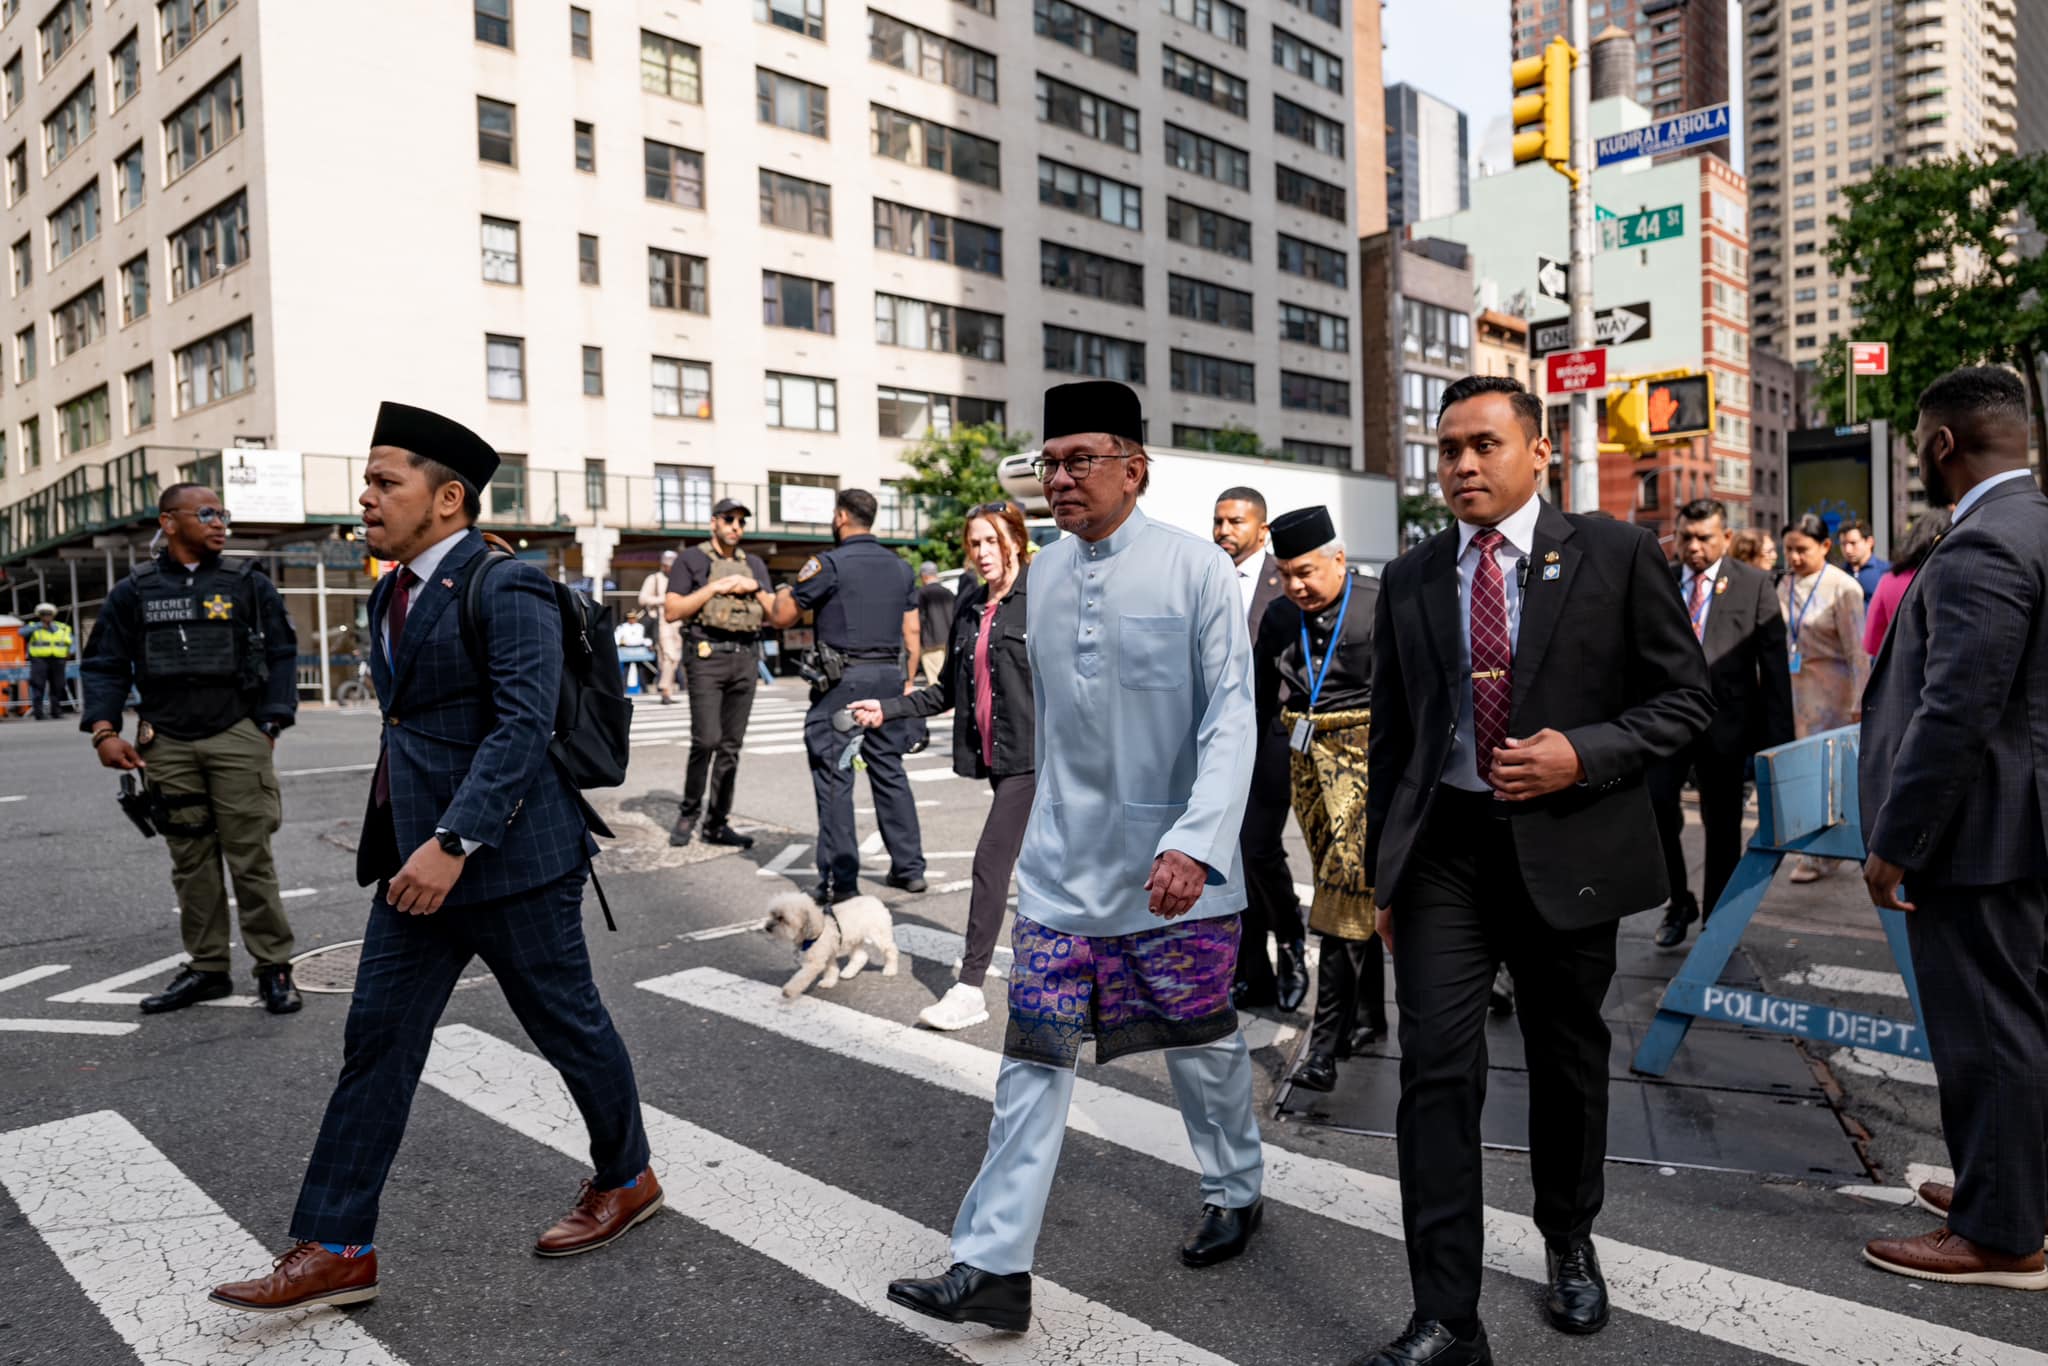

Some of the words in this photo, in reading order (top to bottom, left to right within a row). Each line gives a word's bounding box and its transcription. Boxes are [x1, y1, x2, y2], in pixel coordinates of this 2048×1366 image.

[1600, 124, 1661, 157] KUDIRAT
[1667, 107, 1727, 138] ABIOLA
[1619, 220, 1629, 245] E
[1635, 212, 1660, 241] 44
[1596, 318, 1630, 336] WAY
[1555, 362, 1597, 379] WRONG
[1563, 376, 1588, 390] WAY
[147, 598, 191, 611] SECRET
[146, 609, 193, 622] SERVICE
[1703, 986, 1810, 1032] POLICE
[1828, 1010, 1921, 1053] DEPT.
